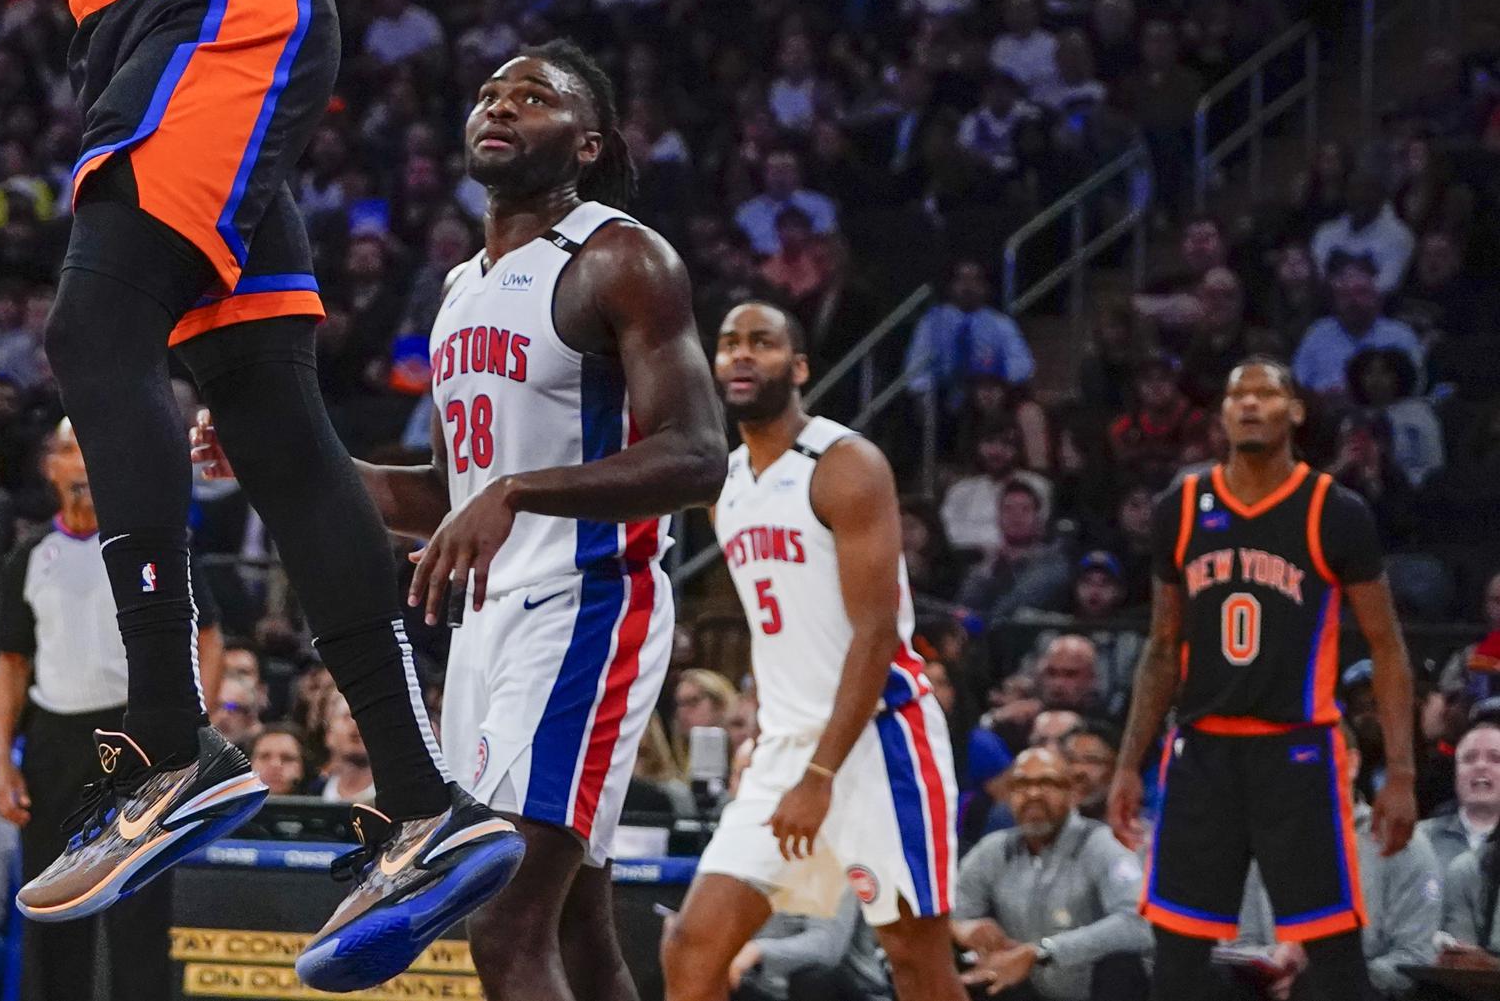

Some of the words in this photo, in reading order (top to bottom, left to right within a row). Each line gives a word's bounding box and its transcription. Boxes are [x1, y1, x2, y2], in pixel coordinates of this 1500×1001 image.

[502, 274, 534, 287] UWM
[446, 393, 494, 475] 28
[1184, 547, 1234, 599] NEW
[1238, 547, 1305, 605] YORK
[755, 578, 783, 636] 5
[1221, 592, 1262, 666] 0
